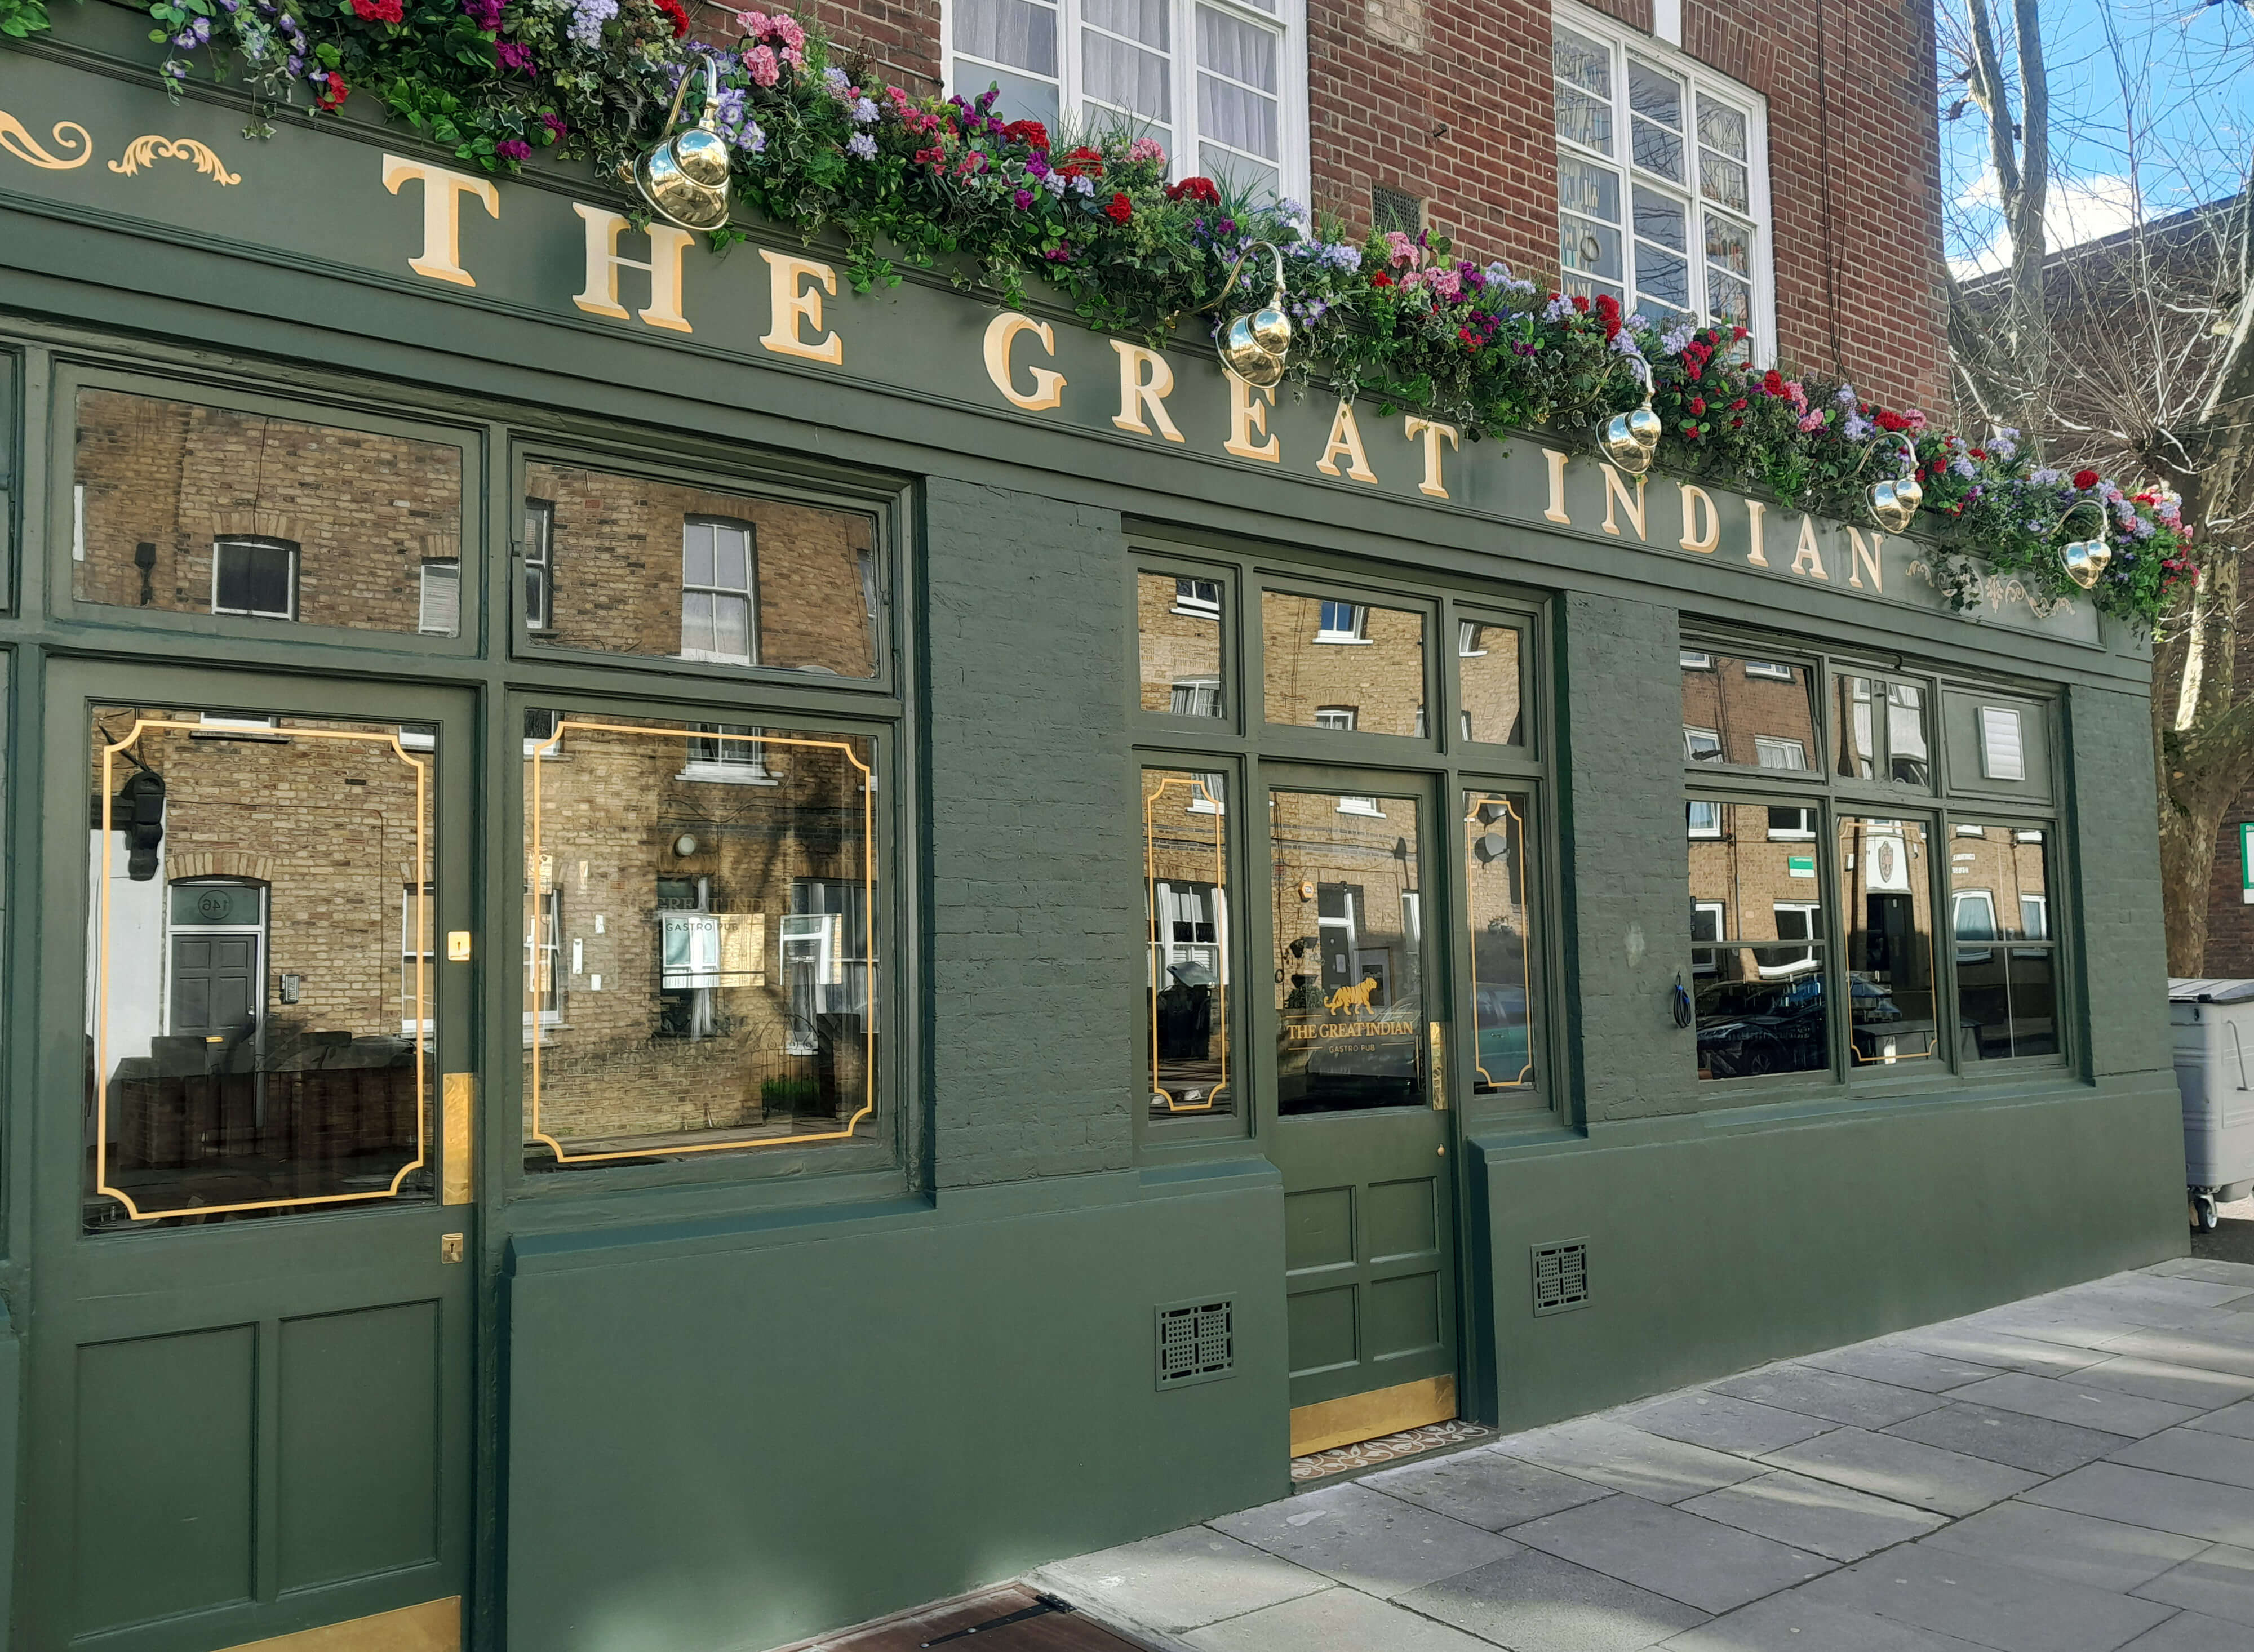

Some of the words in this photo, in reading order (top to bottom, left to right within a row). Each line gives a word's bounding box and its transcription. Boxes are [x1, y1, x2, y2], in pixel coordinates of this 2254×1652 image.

[382, 153, 842, 365] THE
[983, 312, 1458, 499] GREAT
[1542, 448, 1884, 594] INDIAN
[666, 923, 713, 931] GASTRO
[1286, 1024, 1317, 1040] THE
[1319, 1022, 1364, 1038] GREAT
[1365, 1021, 1413, 1036] INDIAN
